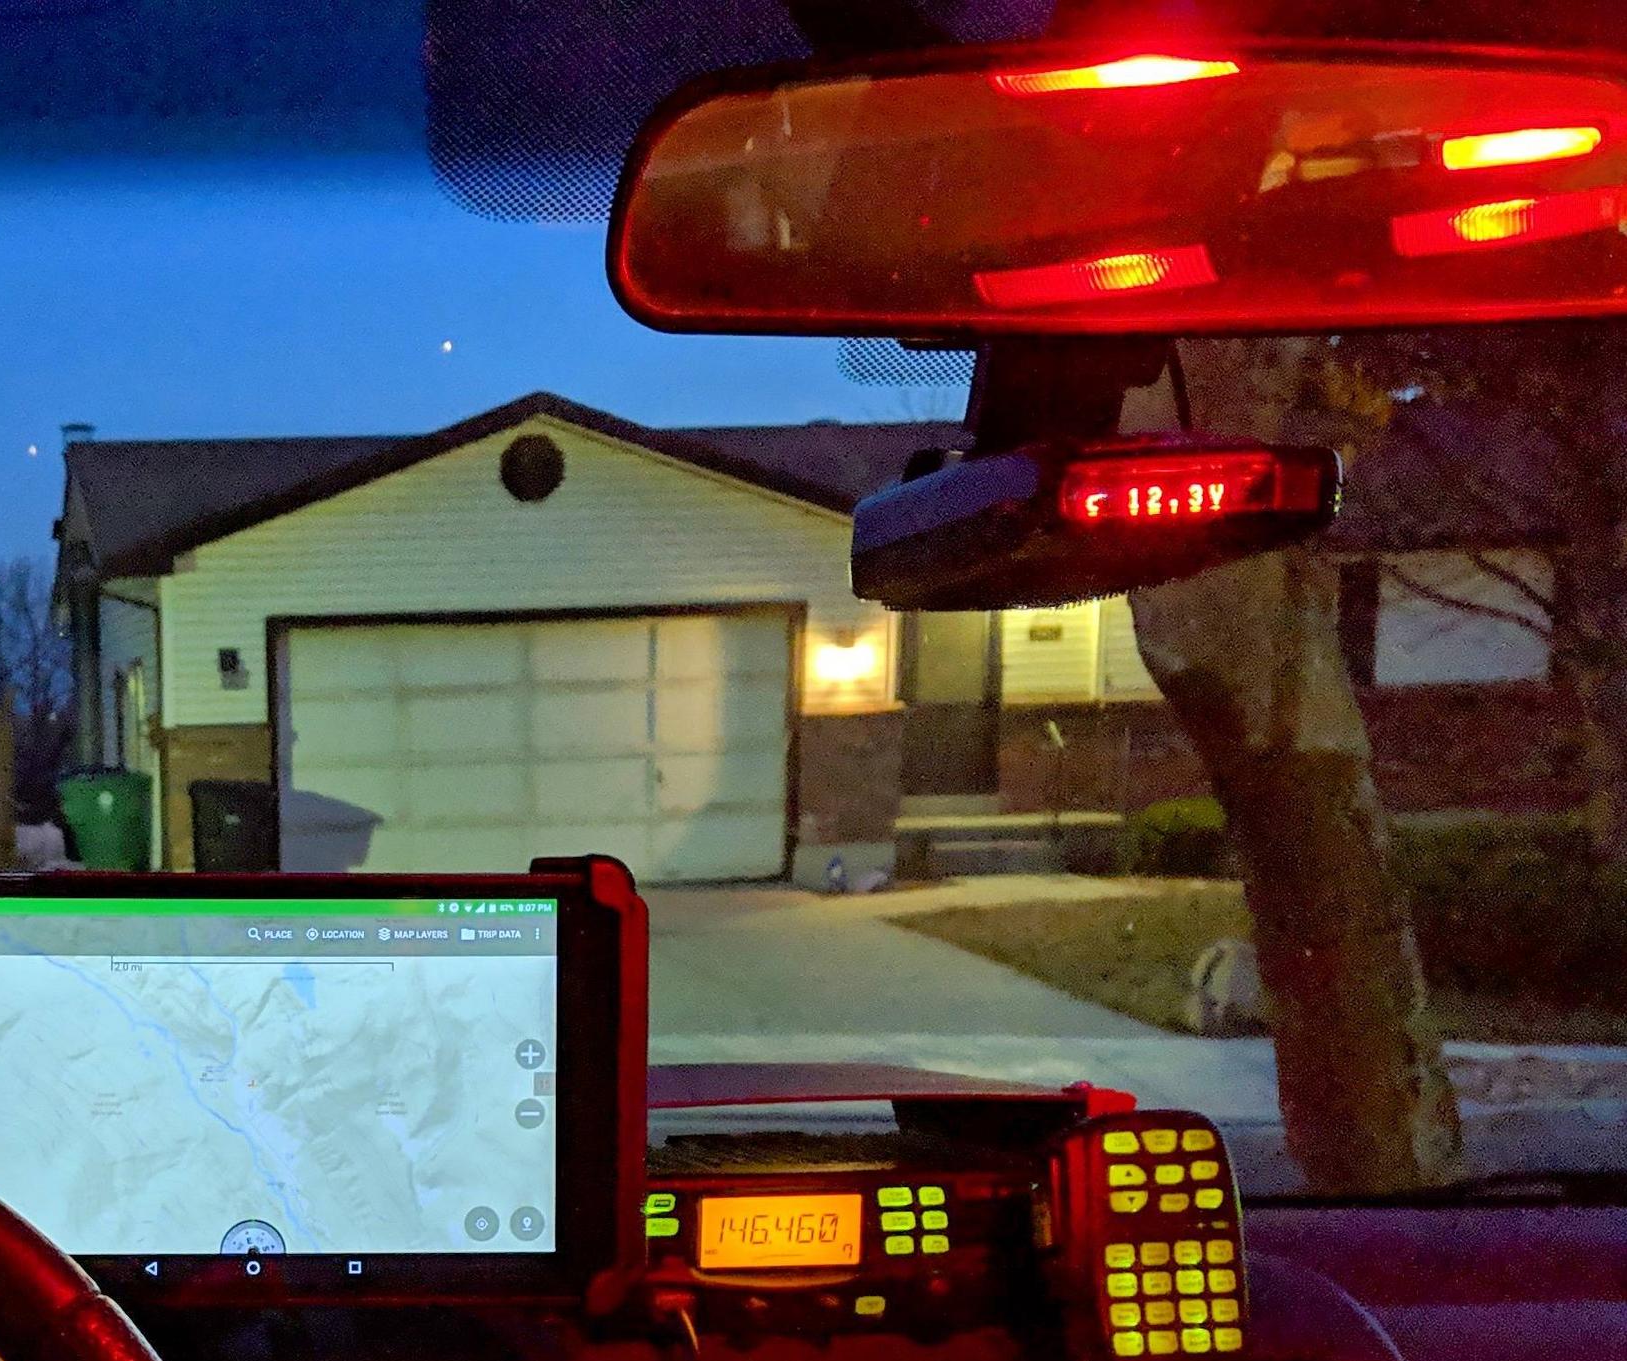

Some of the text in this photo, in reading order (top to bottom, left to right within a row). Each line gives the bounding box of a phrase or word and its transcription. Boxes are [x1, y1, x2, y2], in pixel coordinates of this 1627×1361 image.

[264, 930, 293, 939] PLACE
[322, 930, 365, 939] LOCATION
[394, 930, 449, 939] MAP LAYERS
[477, 930, 522, 939] TRIP DATA
